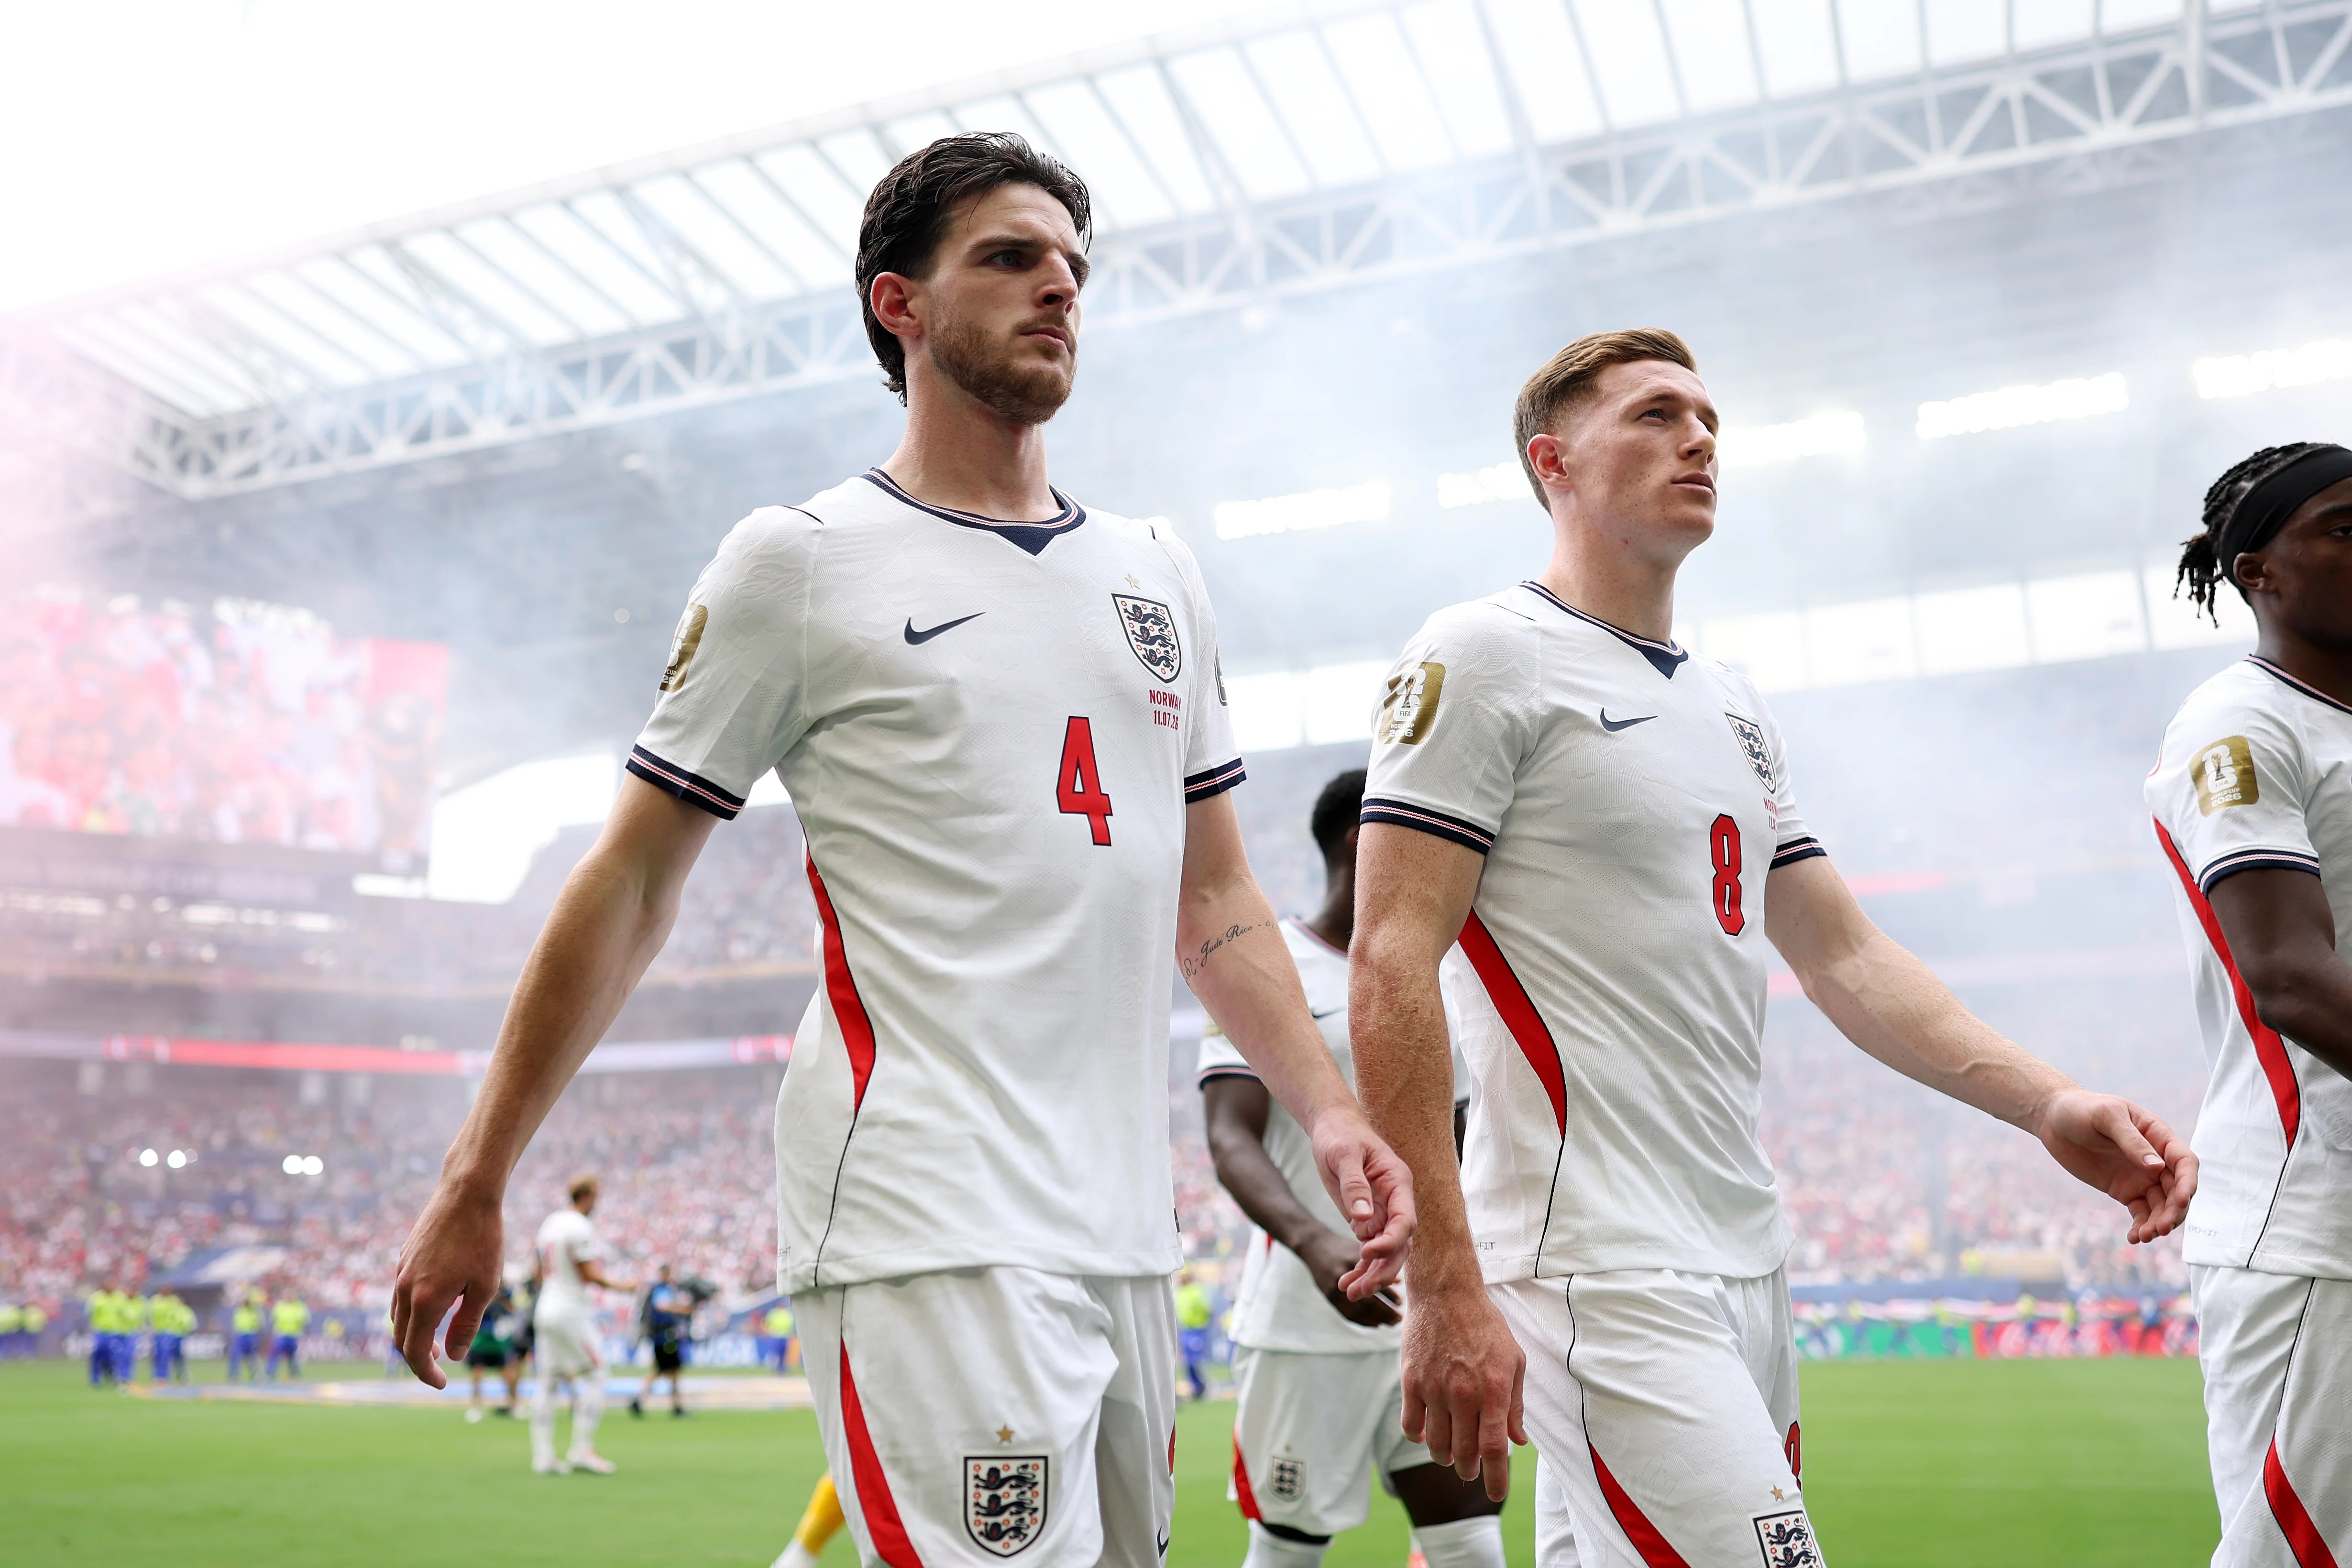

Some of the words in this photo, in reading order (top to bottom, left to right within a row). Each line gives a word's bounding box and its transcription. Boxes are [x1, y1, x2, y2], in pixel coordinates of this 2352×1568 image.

[1149, 689, 1181, 712] NORWAY
[1154, 710, 1178, 731] 11.07.26
[1056, 715, 1113, 846] 4
[2210, 790, 2227, 801] WORLD
[2211, 793, 2242, 808] 2026
[1710, 813, 1745, 936] 8
[1201, 938, 1223, 967] Jude
[1226, 923, 1253, 942] Rice
